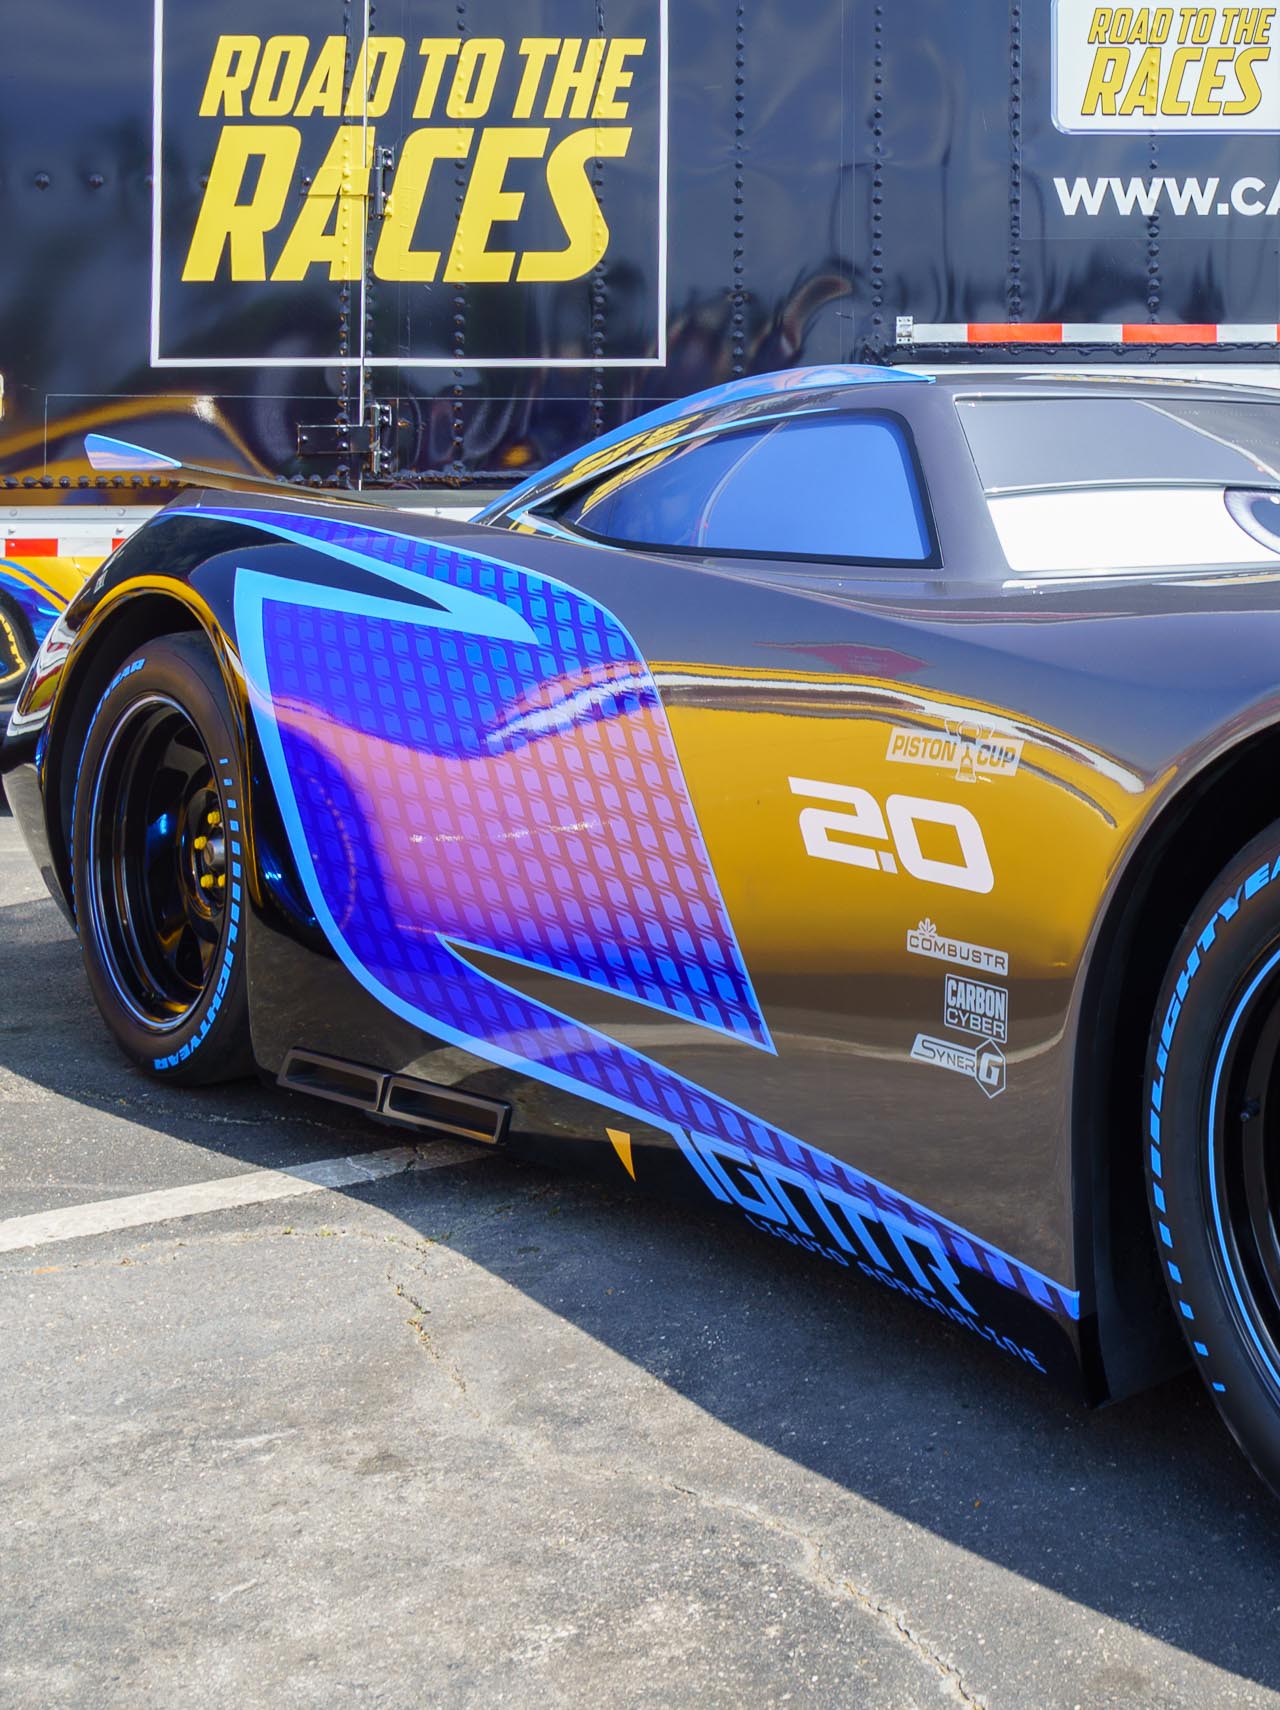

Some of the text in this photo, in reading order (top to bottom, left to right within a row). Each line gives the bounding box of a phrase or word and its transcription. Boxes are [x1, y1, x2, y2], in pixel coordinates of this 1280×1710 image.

[1088, 8, 1276, 44] ROAD TO THE
[199, 35, 646, 119] ROAD TO THE
[1081, 47, 1271, 116] RACES
[181, 125, 633, 283] RACES
[891, 735, 1017, 768] PISTON CUP
[787, 776, 995, 894] 2.0
[909, 935, 1006, 969] COMBUSTR
[948, 979, 1006, 1021] CARBON
[946, 1008, 1005, 1038] CYBER
